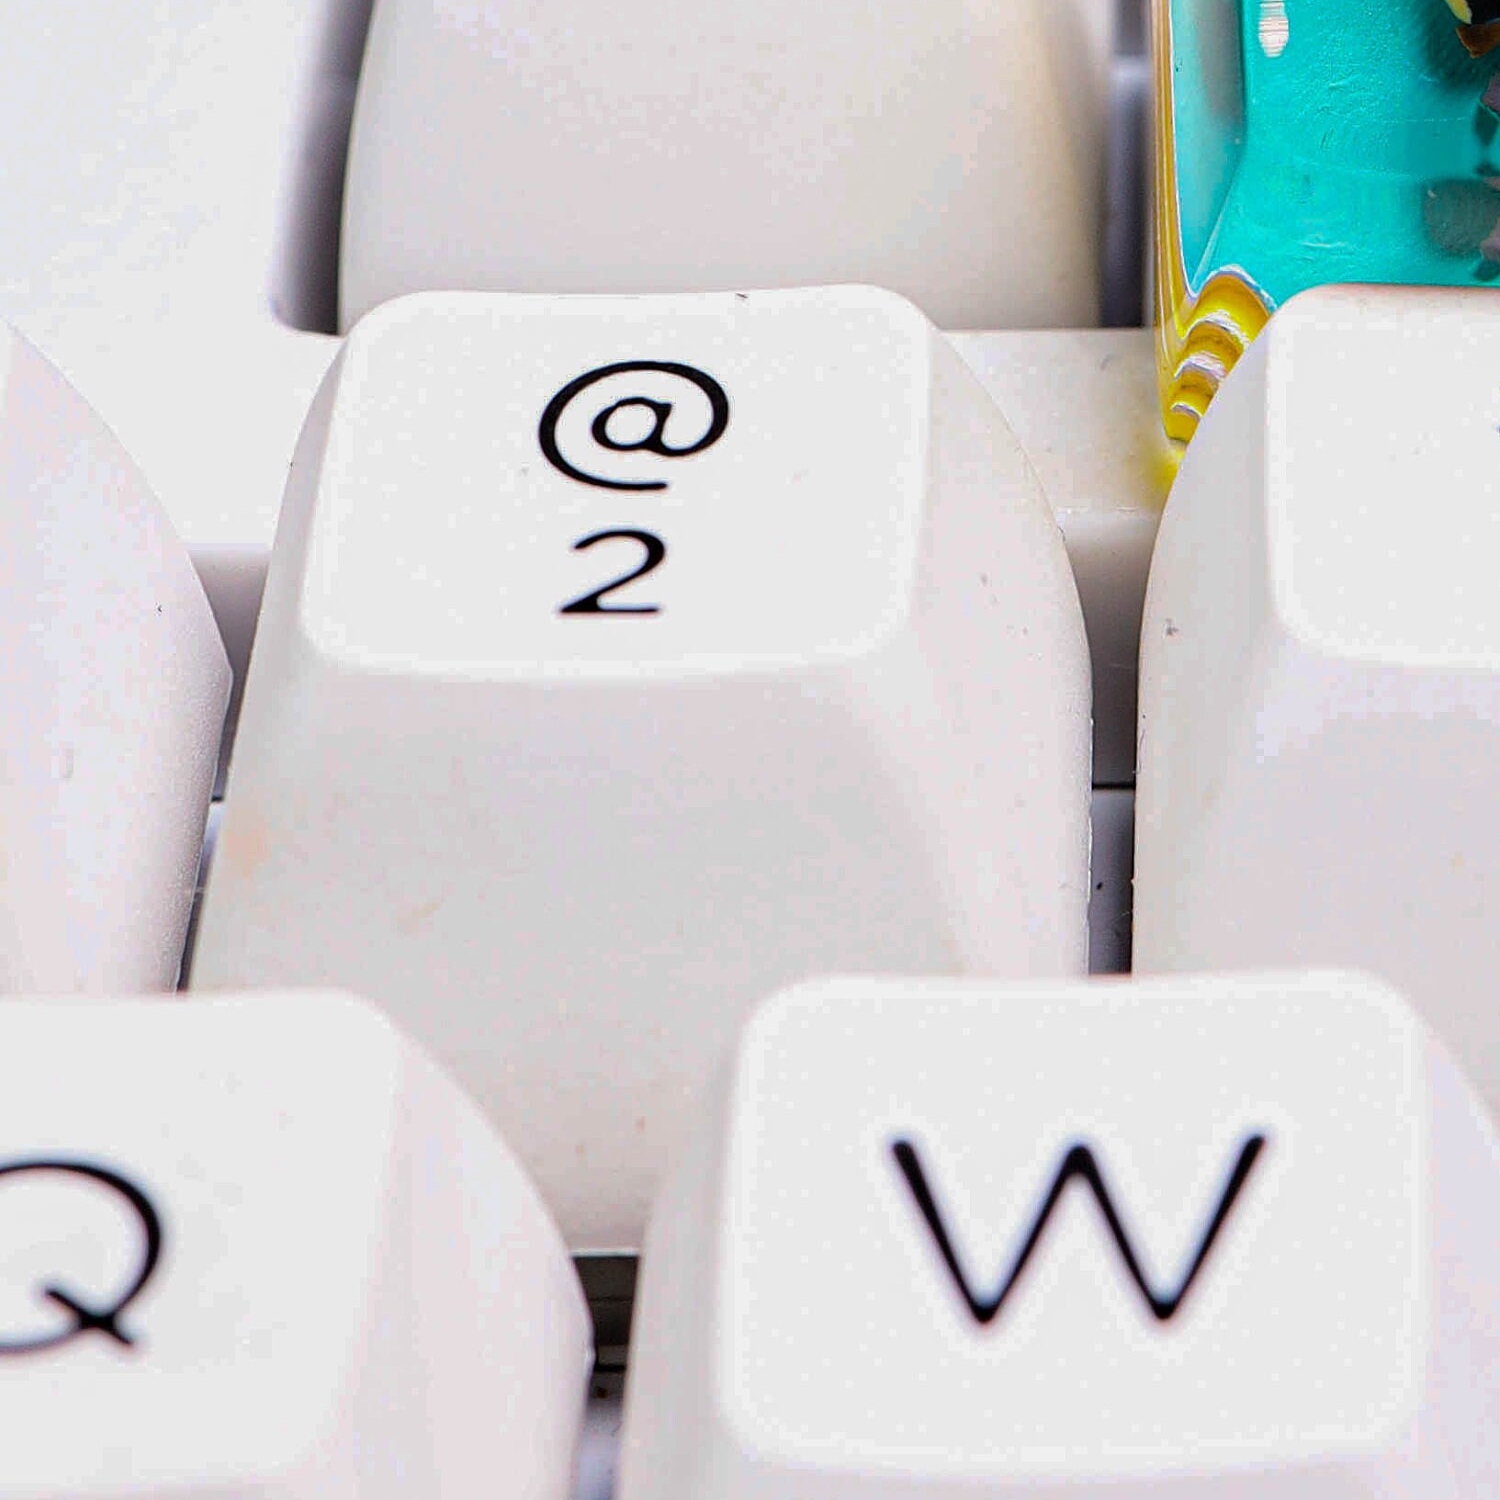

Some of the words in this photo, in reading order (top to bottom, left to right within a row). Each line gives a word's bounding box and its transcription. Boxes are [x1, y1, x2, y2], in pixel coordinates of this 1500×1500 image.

[537, 360, 730, 492] @
[559, 527, 668, 615] 2
[0, 1159, 166, 1355] Q
[890, 1132, 1267, 1328] W
